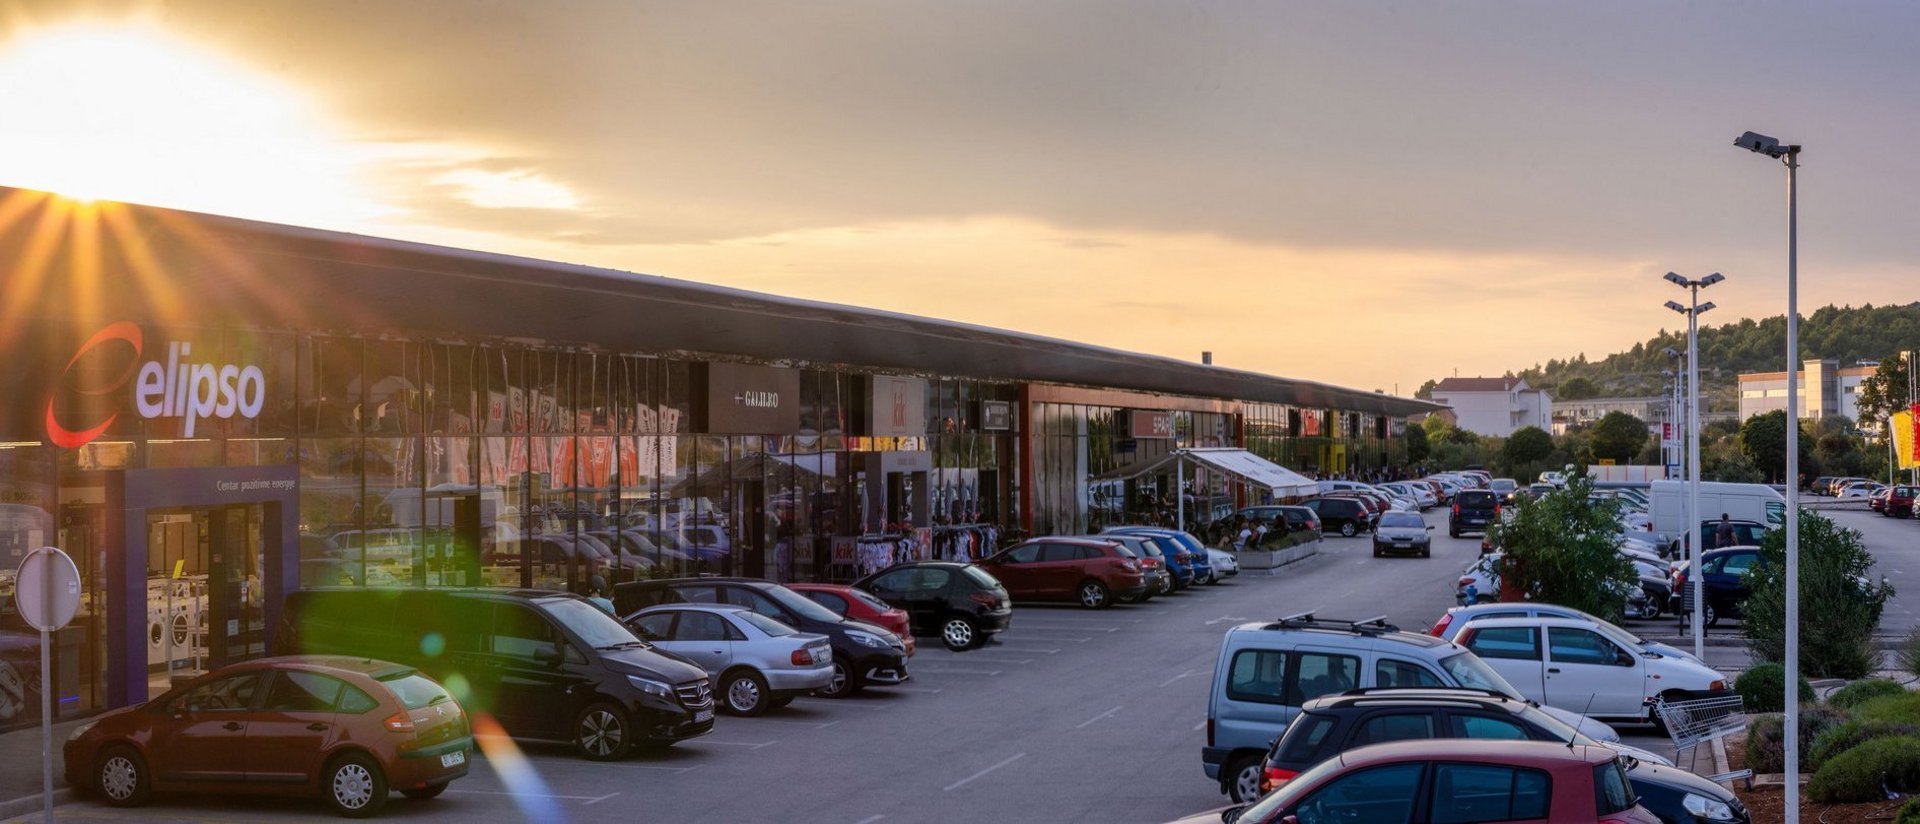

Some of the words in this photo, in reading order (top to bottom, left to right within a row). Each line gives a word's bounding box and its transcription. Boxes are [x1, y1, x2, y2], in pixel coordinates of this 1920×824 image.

[135, 341, 265, 438] elipso
[893, 391, 906, 428] kik
[1153, 415, 1170, 434] SPAR
[216, 480, 239, 491] Centar
[240, 478, 271, 492] pozitivne
[835, 542, 854, 560] kik
